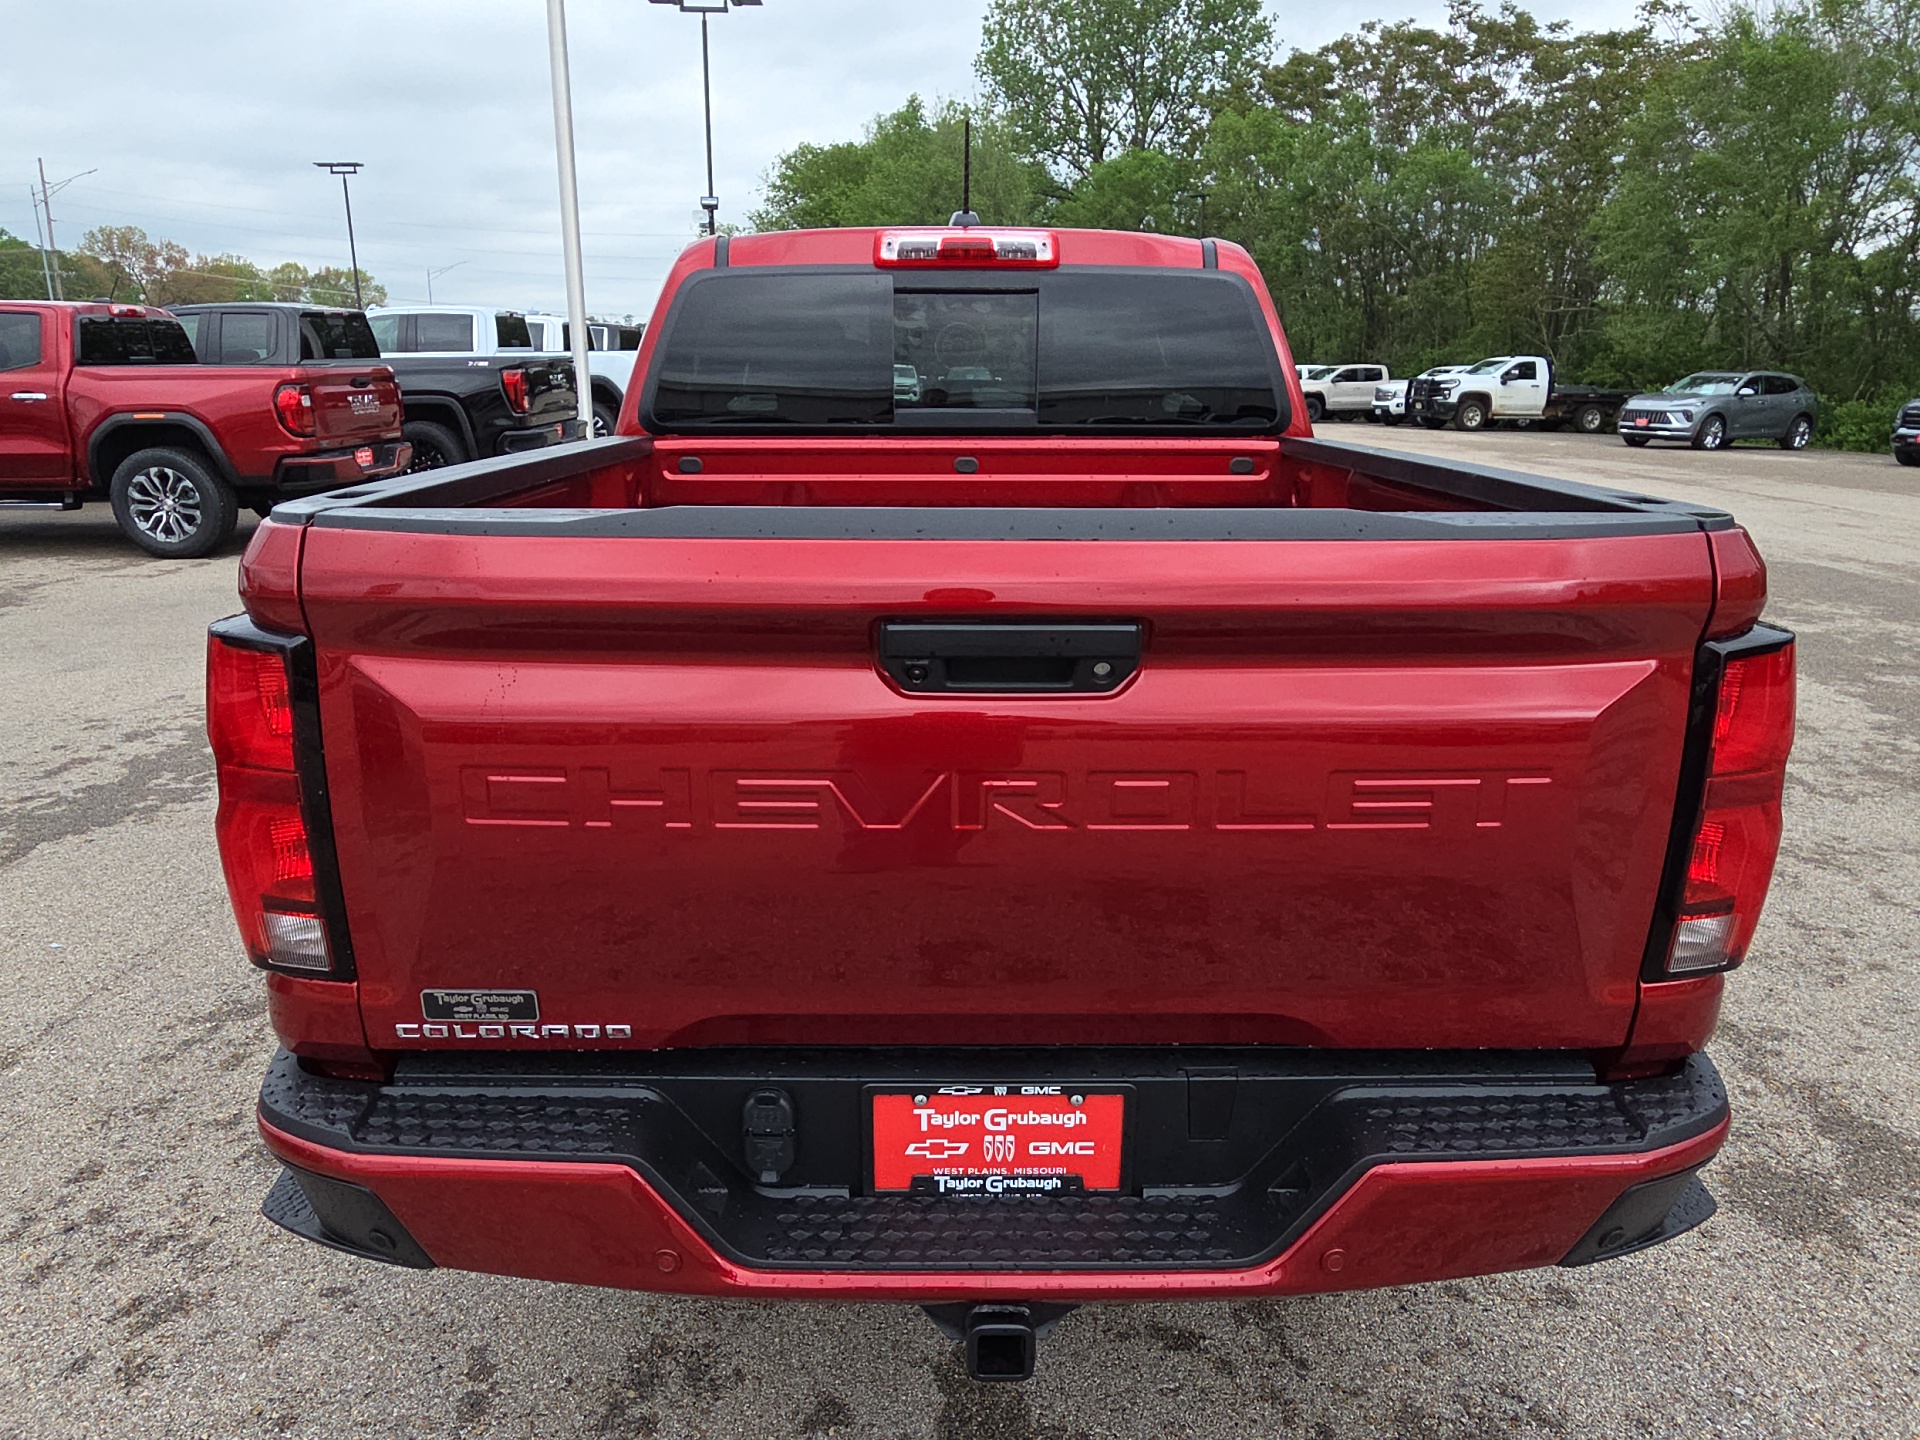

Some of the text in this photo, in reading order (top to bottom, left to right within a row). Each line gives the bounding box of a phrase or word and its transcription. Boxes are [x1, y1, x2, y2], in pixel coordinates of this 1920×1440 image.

[460, 766, 1553, 829] CHEVROLET
[434, 993, 524, 1005] Taylor Grubaugh
[395, 1024, 632, 1039] COLORADO
[1021, 1086, 1061, 1095] GMC
[913, 1108, 1087, 1131] Taylor Grubaugh
[1029, 1141, 1095, 1155] GMC
[933, 1167, 964, 1175] WEST
[1014, 1167, 1067, 1175] MISSOURI
[934, 1176, 1061, 1192] Taylor Grubaugh
